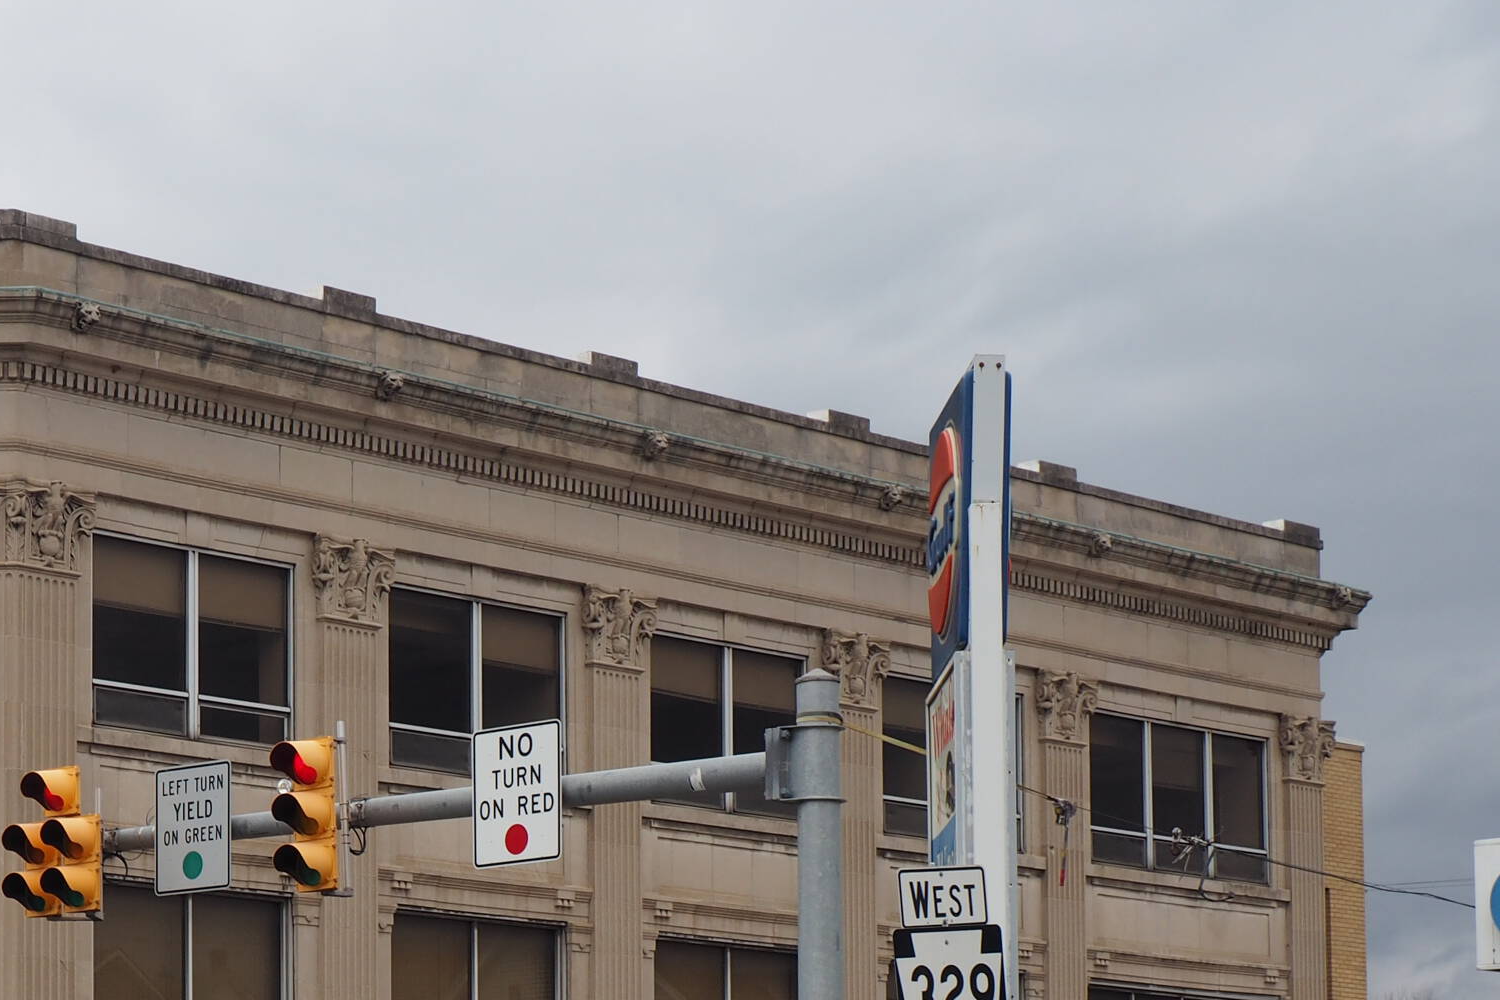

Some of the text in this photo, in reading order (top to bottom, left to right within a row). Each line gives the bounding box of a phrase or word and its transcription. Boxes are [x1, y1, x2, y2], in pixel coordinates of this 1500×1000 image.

[499, 732, 533, 760] NO
[162, 774, 224, 797] LEFT TURN
[492, 763, 541, 790] TURN
[173, 799, 213, 822] YIELD
[479, 792, 554, 821] ON RED
[163, 825, 222, 847] ON GREEN
[909, 880, 975, 919] WEST
